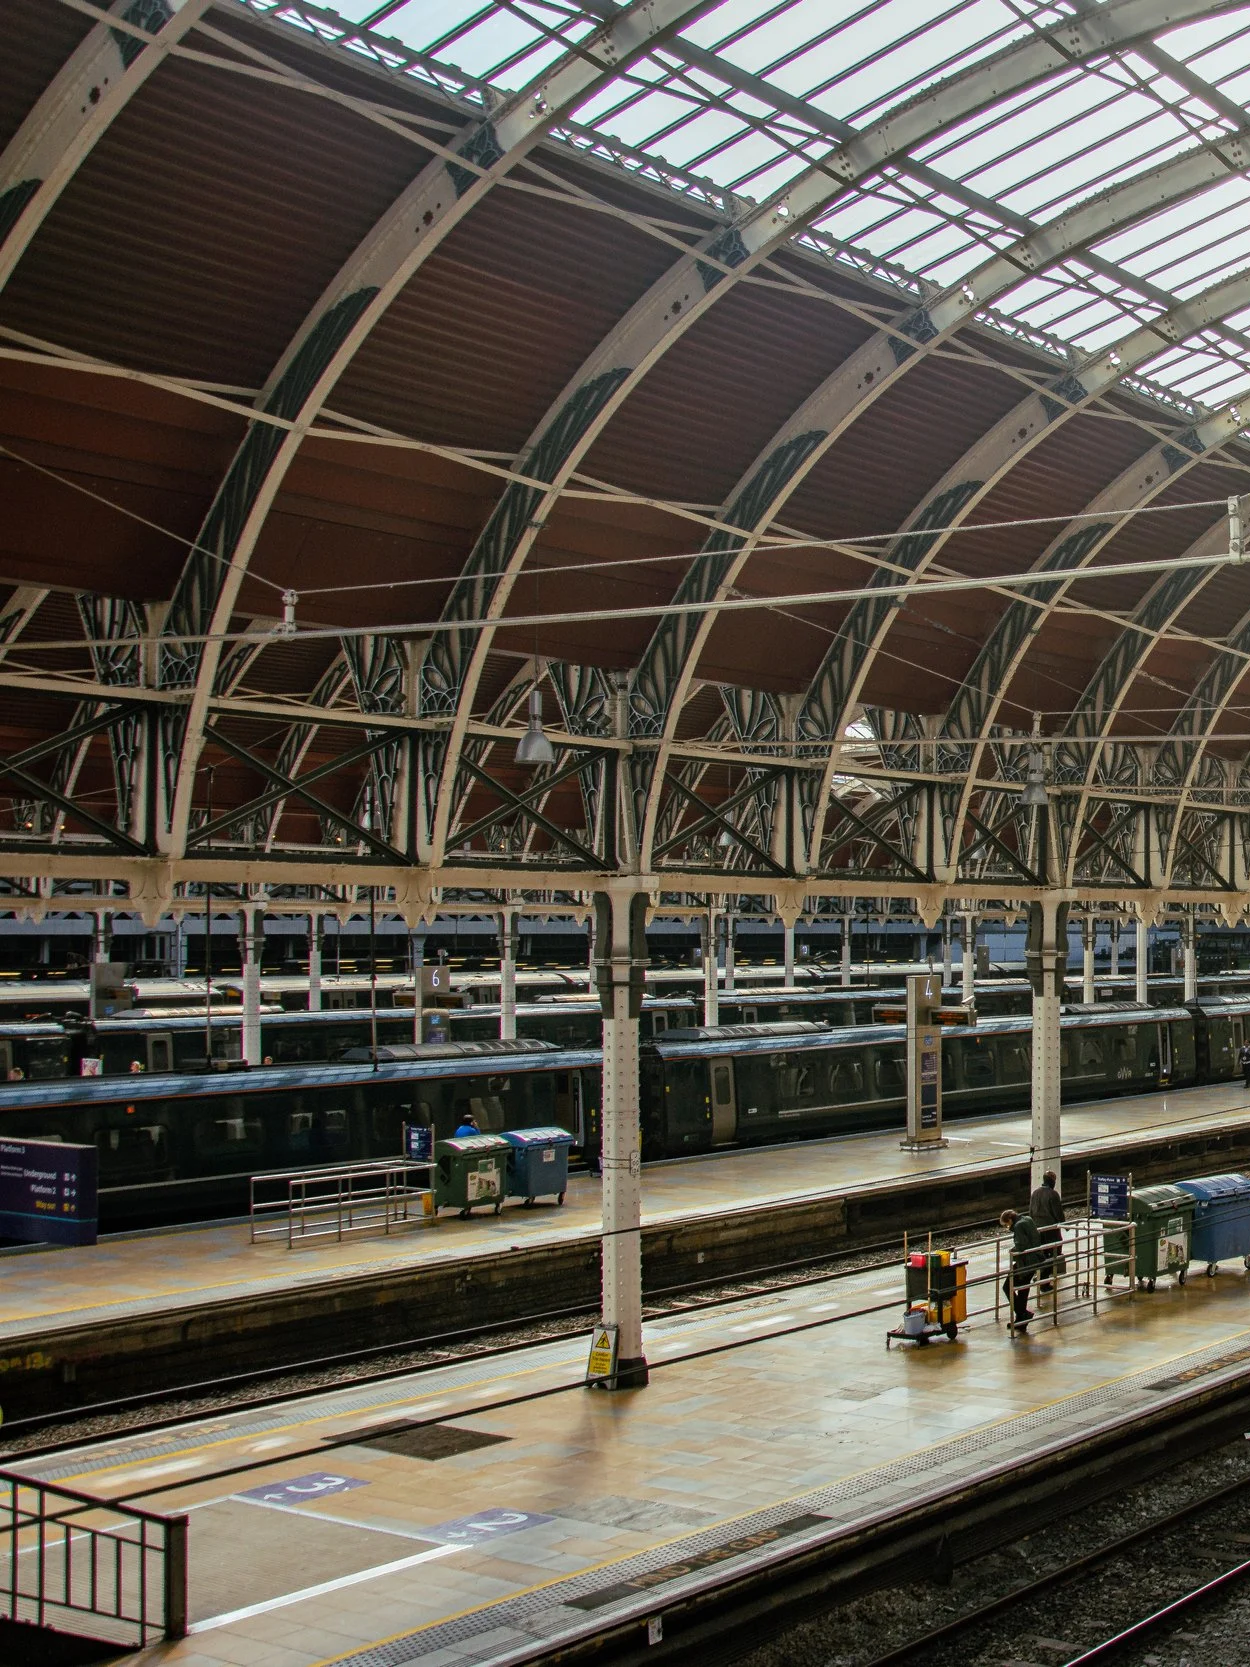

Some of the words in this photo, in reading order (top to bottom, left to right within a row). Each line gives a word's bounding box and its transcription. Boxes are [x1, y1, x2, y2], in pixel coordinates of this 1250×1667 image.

[432, 969, 440, 986] 6
[926, 980, 932, 1000] 4
[24, 1169, 56, 1180] Underground
[31, 1184, 52, 1194] Platform
[286, 1477, 346, 1493] 3
[466, 1513, 528, 1531] 2
